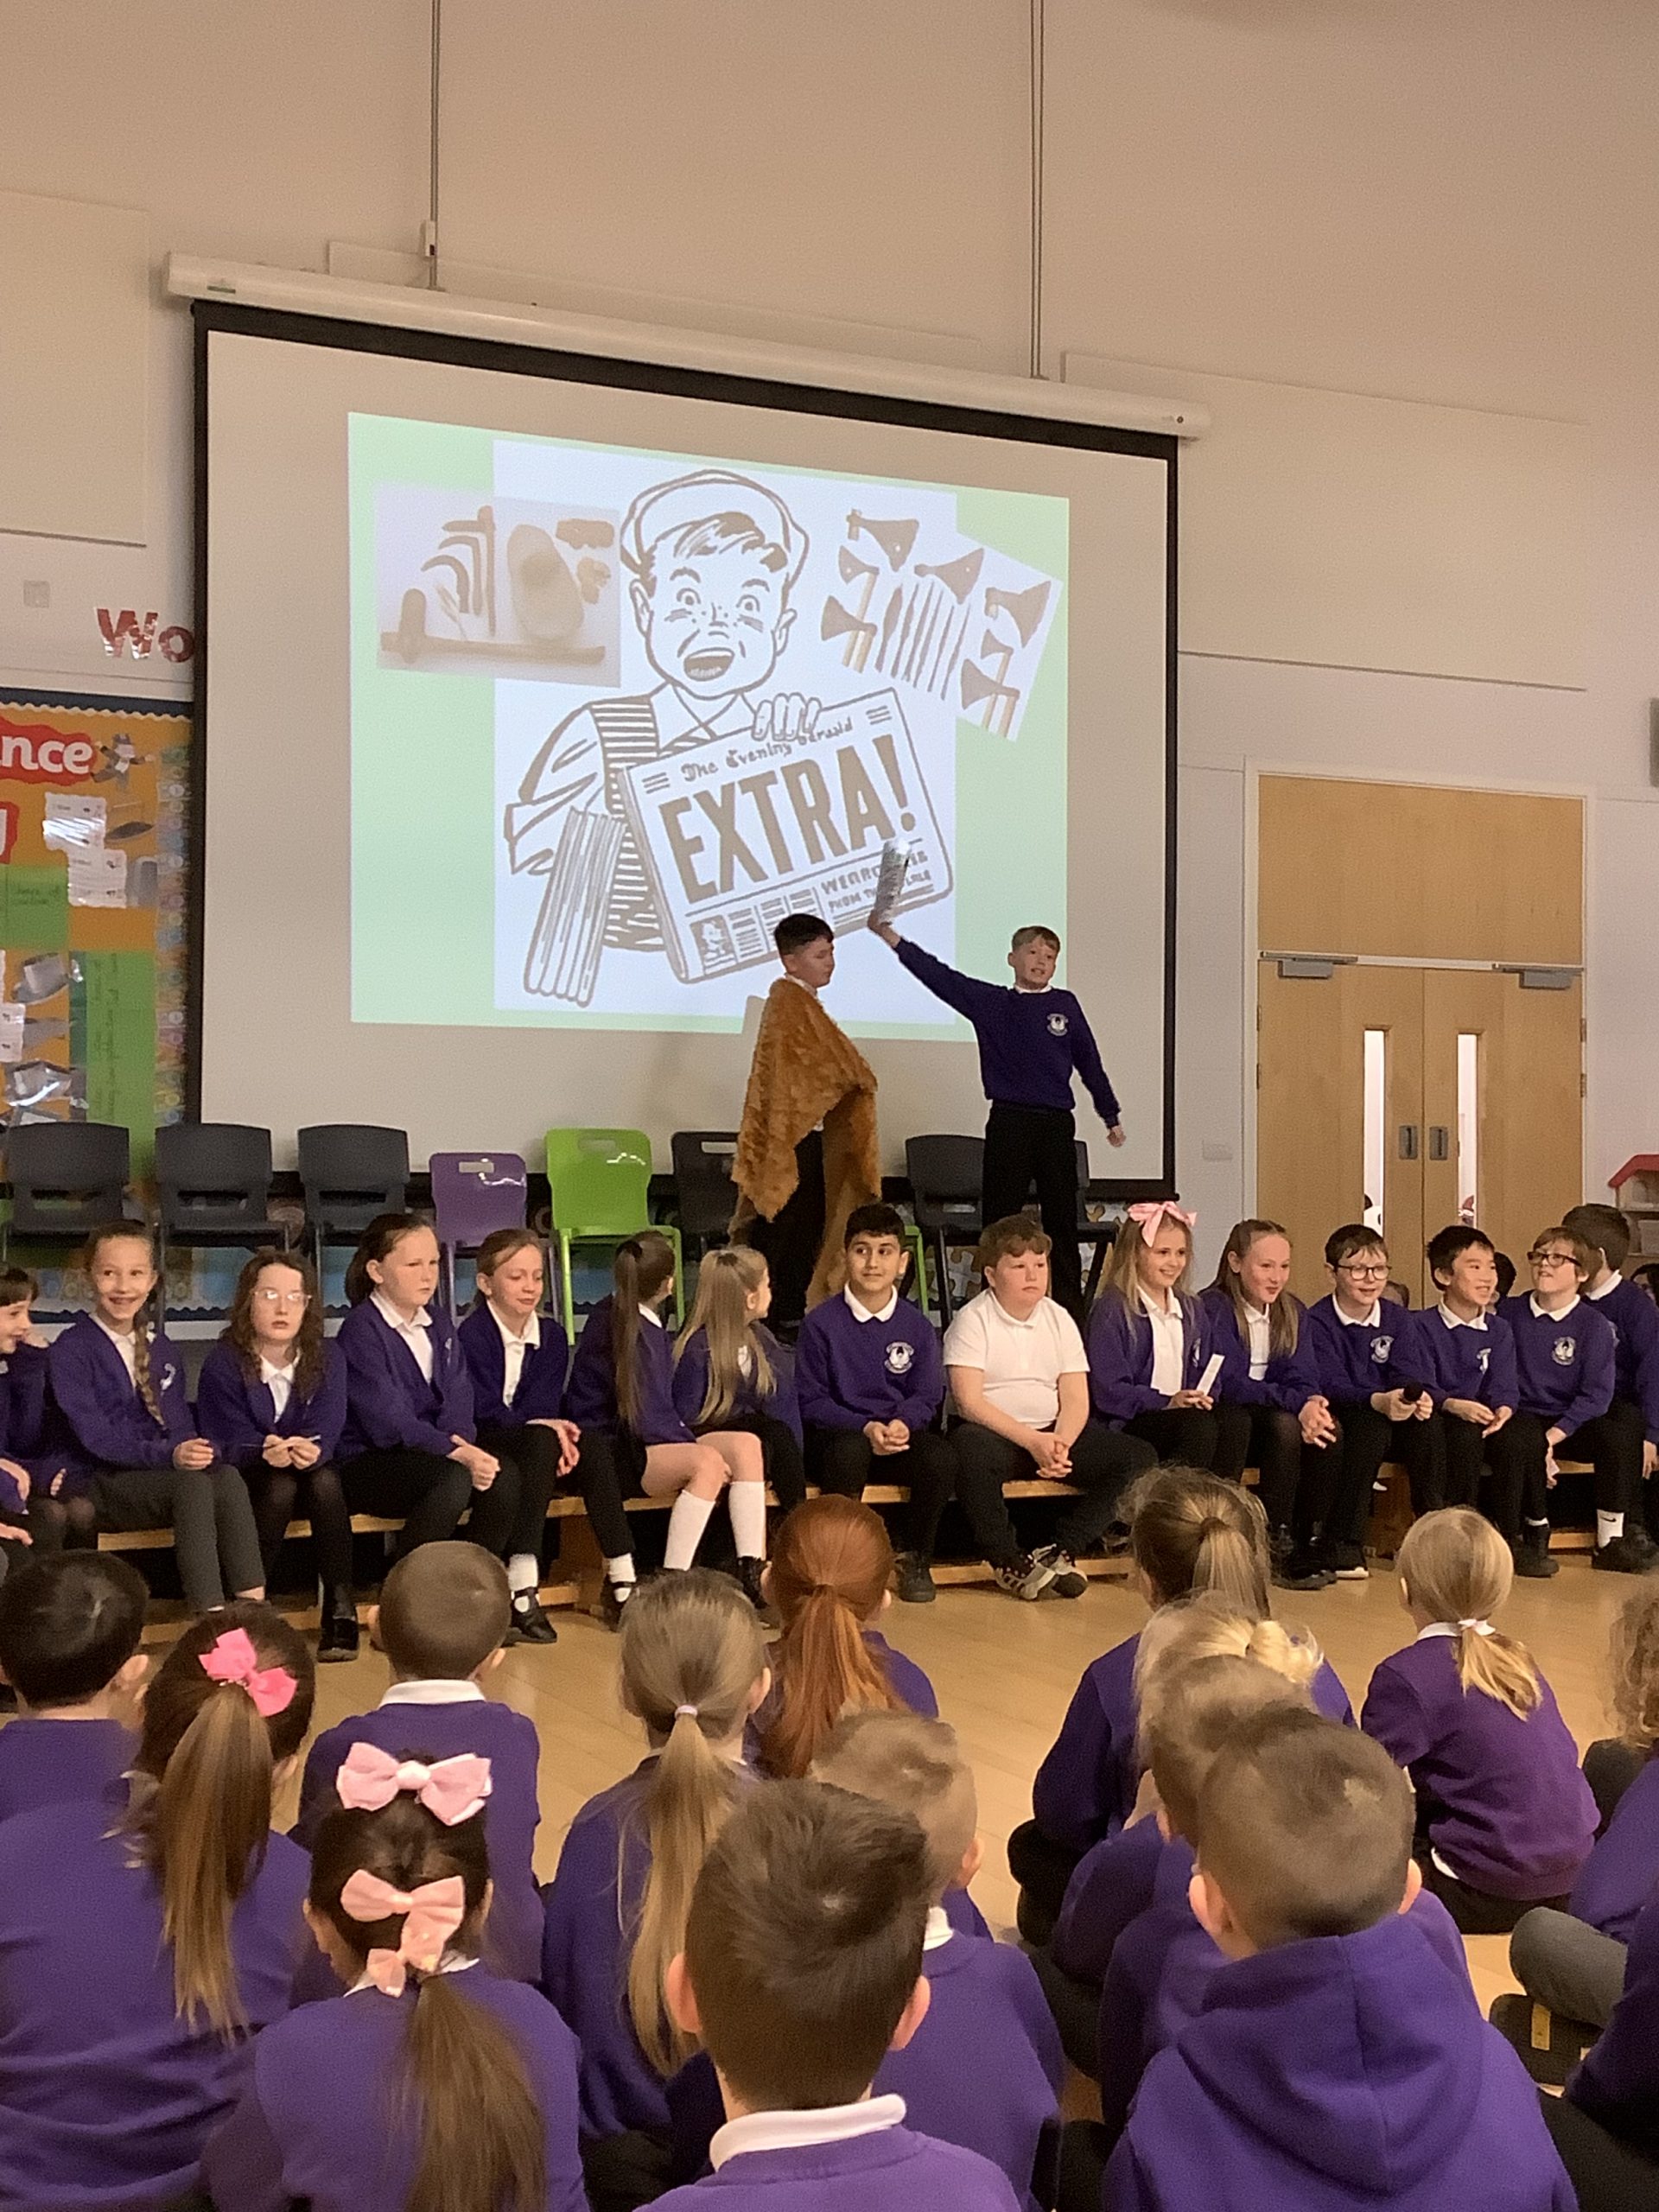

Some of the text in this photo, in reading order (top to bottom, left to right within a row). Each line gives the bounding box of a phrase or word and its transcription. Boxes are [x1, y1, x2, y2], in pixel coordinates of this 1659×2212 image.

[0, 735, 93, 775] nce
[681, 761, 719, 782] The
[725, 742, 792, 769] Evening
[658, 734, 916, 904] EXTRA!
